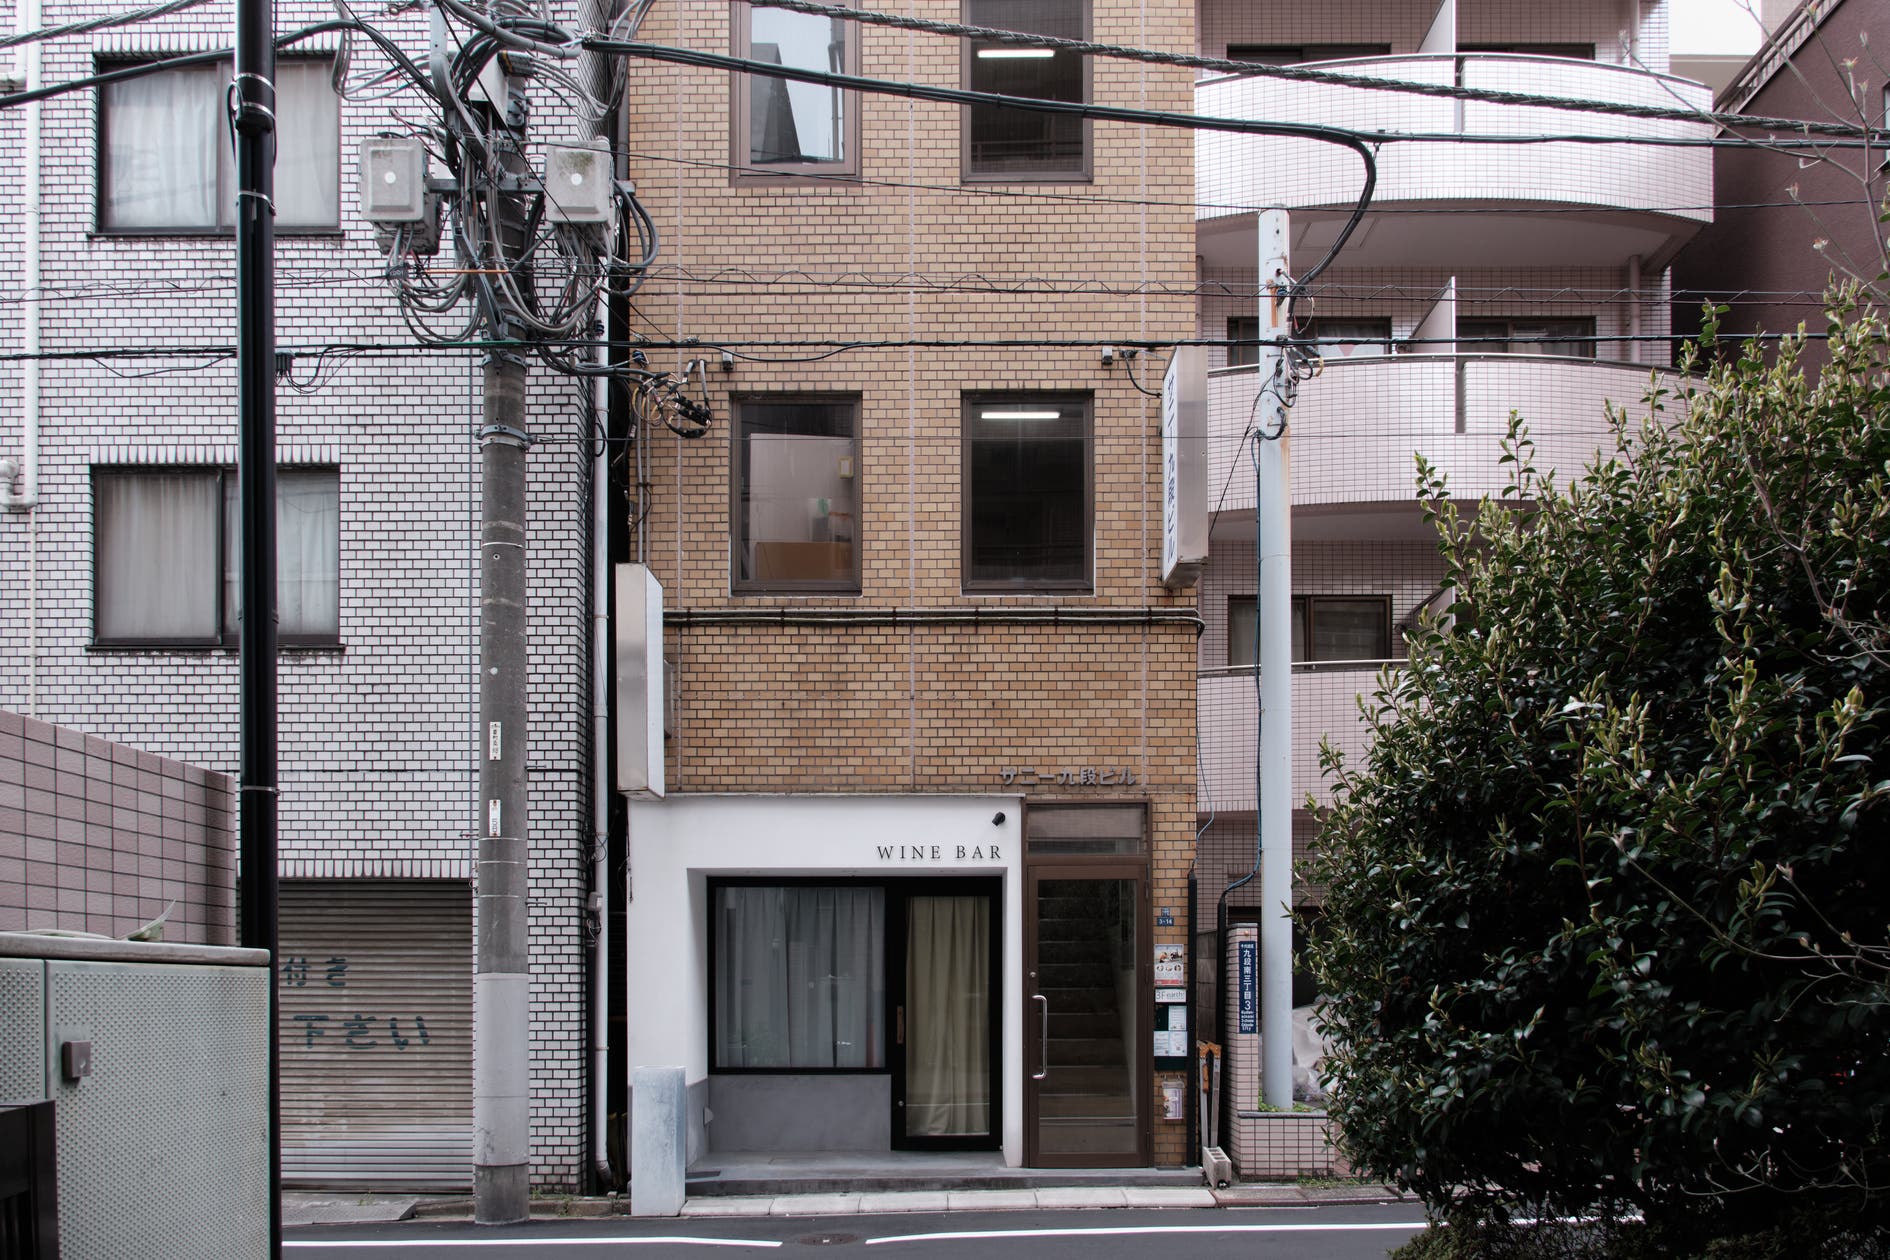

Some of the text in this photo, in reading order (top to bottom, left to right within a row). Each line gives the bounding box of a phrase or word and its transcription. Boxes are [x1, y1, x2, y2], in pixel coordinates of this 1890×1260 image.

[1000, 767, 1137, 785] サニー九段ビル
[877, 845, 1001, 859] WINE BAR
[293, 1014, 430, 1050] 下さい
